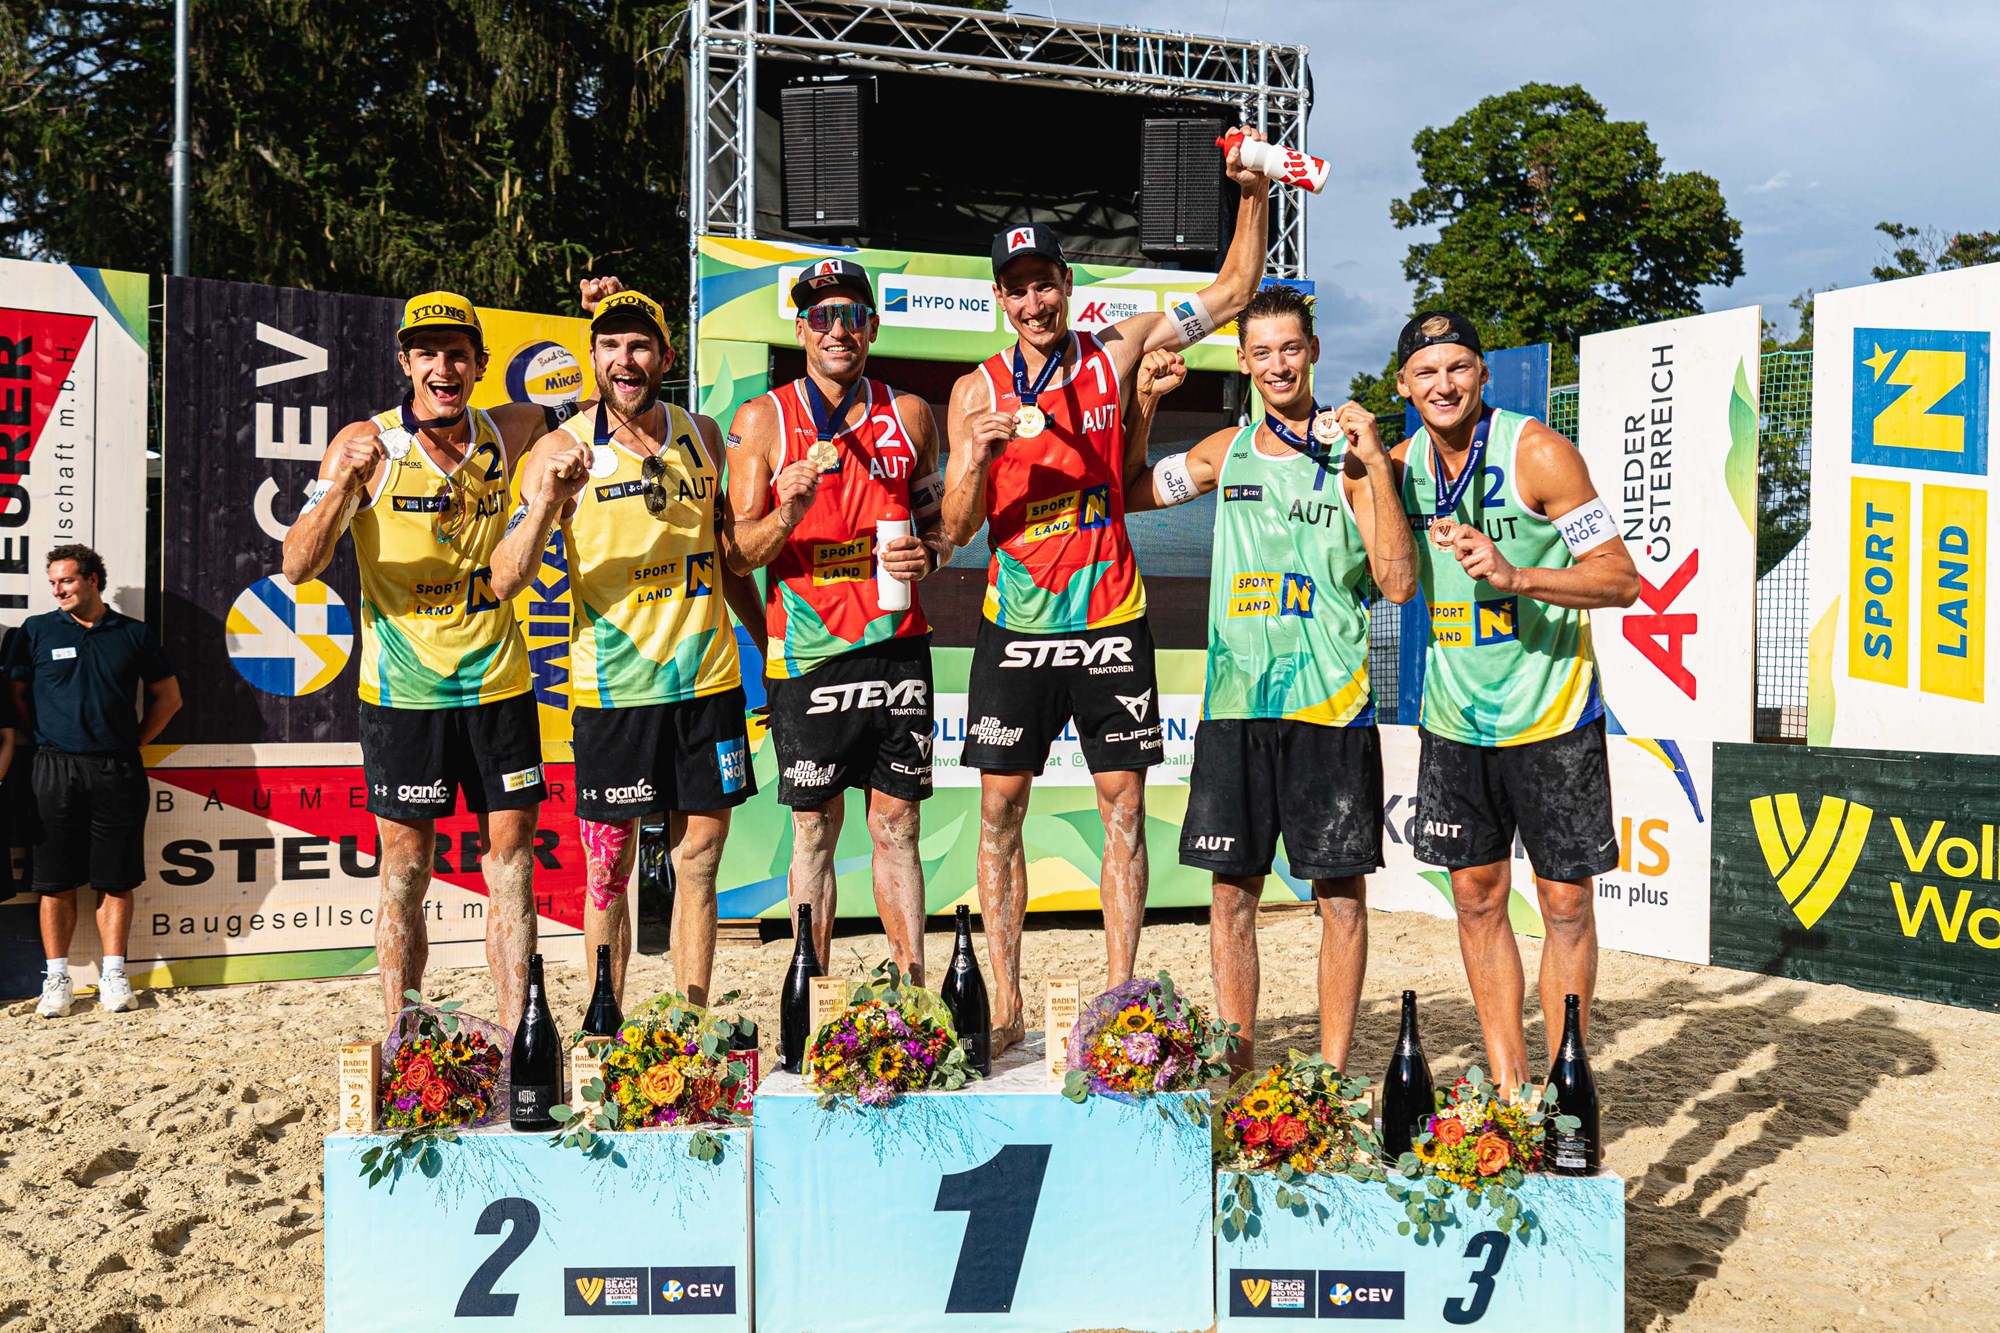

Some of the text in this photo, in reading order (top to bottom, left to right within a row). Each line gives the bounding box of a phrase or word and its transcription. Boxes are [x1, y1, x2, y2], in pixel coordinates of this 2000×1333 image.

[1011, 229, 1031, 249] A1
[820, 260, 839, 276] A1
[411, 303, 466, 321] YTONG
[912, 295, 990, 312] HYPO NOE
[1077, 301, 1108, 324] AK
[1109, 302, 1138, 311] NIEDER
[1085, 355, 1108, 395] 1
[871, 414, 901, 448] 2
[1081, 404, 1117, 435] AUT
[253, 321, 329, 543] CEV
[477, 441, 503, 482] 2
[676, 434, 703, 469] 1
[1646, 343, 1673, 563] ÖSTERREICH
[869, 456, 910, 481] AUT
[1624, 413, 1646, 541] NIEDER
[678, 476, 714, 502] AUT
[1174, 476, 1191, 499] NOE
[1480, 465, 1506, 509] 2
[475, 489, 506, 521] AUT
[1031, 495, 1075, 516] SPORT
[1288, 498, 1339, 529] AUT
[1034, 520, 1070, 537] LAND
[1564, 509, 1604, 536] HYPO
[1568, 522, 1601, 546] NOE
[820, 542, 865, 559] SPORT
[634, 562, 677, 580] SPORT
[823, 567, 860, 580] LAND
[1864, 502, 1894, 661] SPORT
[415, 580, 462, 595] SPORT
[1238, 577, 1274, 589] SPORT
[1938, 524, 1969, 659] LAND
[637, 587, 673, 603] LAND
[1238, 600, 1271, 612] LAND
[416, 605, 454, 616] LAND
[1622, 547, 1699, 701] AK
[998, 636, 1133, 669] STEYR
[1088, 665, 1134, 676] TRAKTOREN
[805, 679, 928, 715] STEYR
[889, 708, 928, 717] TRAKTOREN
[979, 715, 1002, 729] Die
[976, 733, 1015, 747] Profis
[793, 774, 831, 787] Profis
[156, 783, 566, 812] BAUMER
[1423, 819, 1462, 839] AUT
[1194, 835, 1236, 852] AUT
[1890, 816, 2000, 880] Vol
[1599, 877, 1669, 907] im plus
[152, 900, 443, 937] Baugesellscft
[350, 1093, 361, 1109] 2
[933, 1143, 1053, 1314] 1
[453, 1196, 541, 1318] 2
[605, 1280, 638, 1289] BEACH
[1271, 1282, 1305, 1291] BEACH
[1442, 1230, 1511, 1325] 3
[687, 1283, 724, 1298] CEV
[1355, 1288, 1394, 1303] CEV
